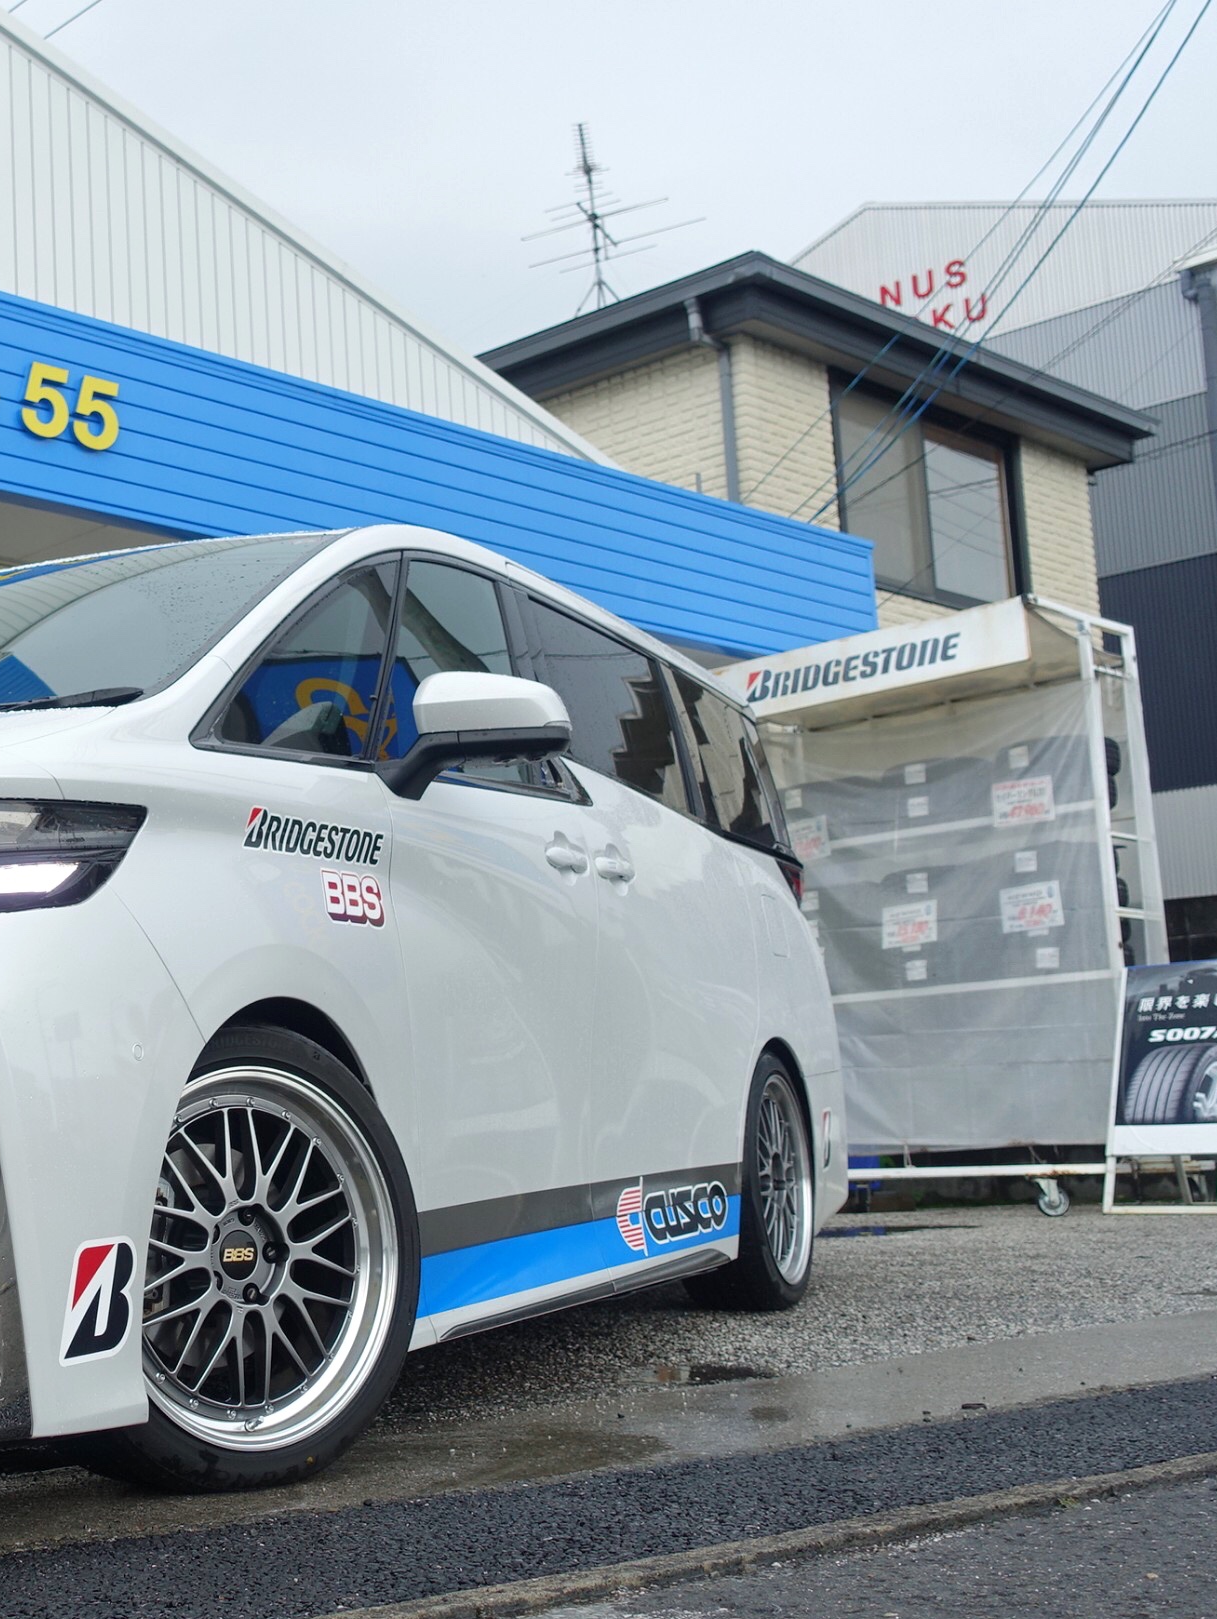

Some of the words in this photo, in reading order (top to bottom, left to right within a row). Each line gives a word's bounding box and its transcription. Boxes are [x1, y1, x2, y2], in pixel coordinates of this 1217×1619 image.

[880, 259, 967, 306] NUS
[912, 293, 987, 330] KU
[22, 361, 120, 451] 55
[747, 632, 961, 702] BRIDGESTONE
[243, 807, 384, 865] BRIDGESTONE
[321, 869, 385, 928] BBS
[1149, 1026, 1217, 1042] S007
[222, 1247, 255, 1262] BBS
